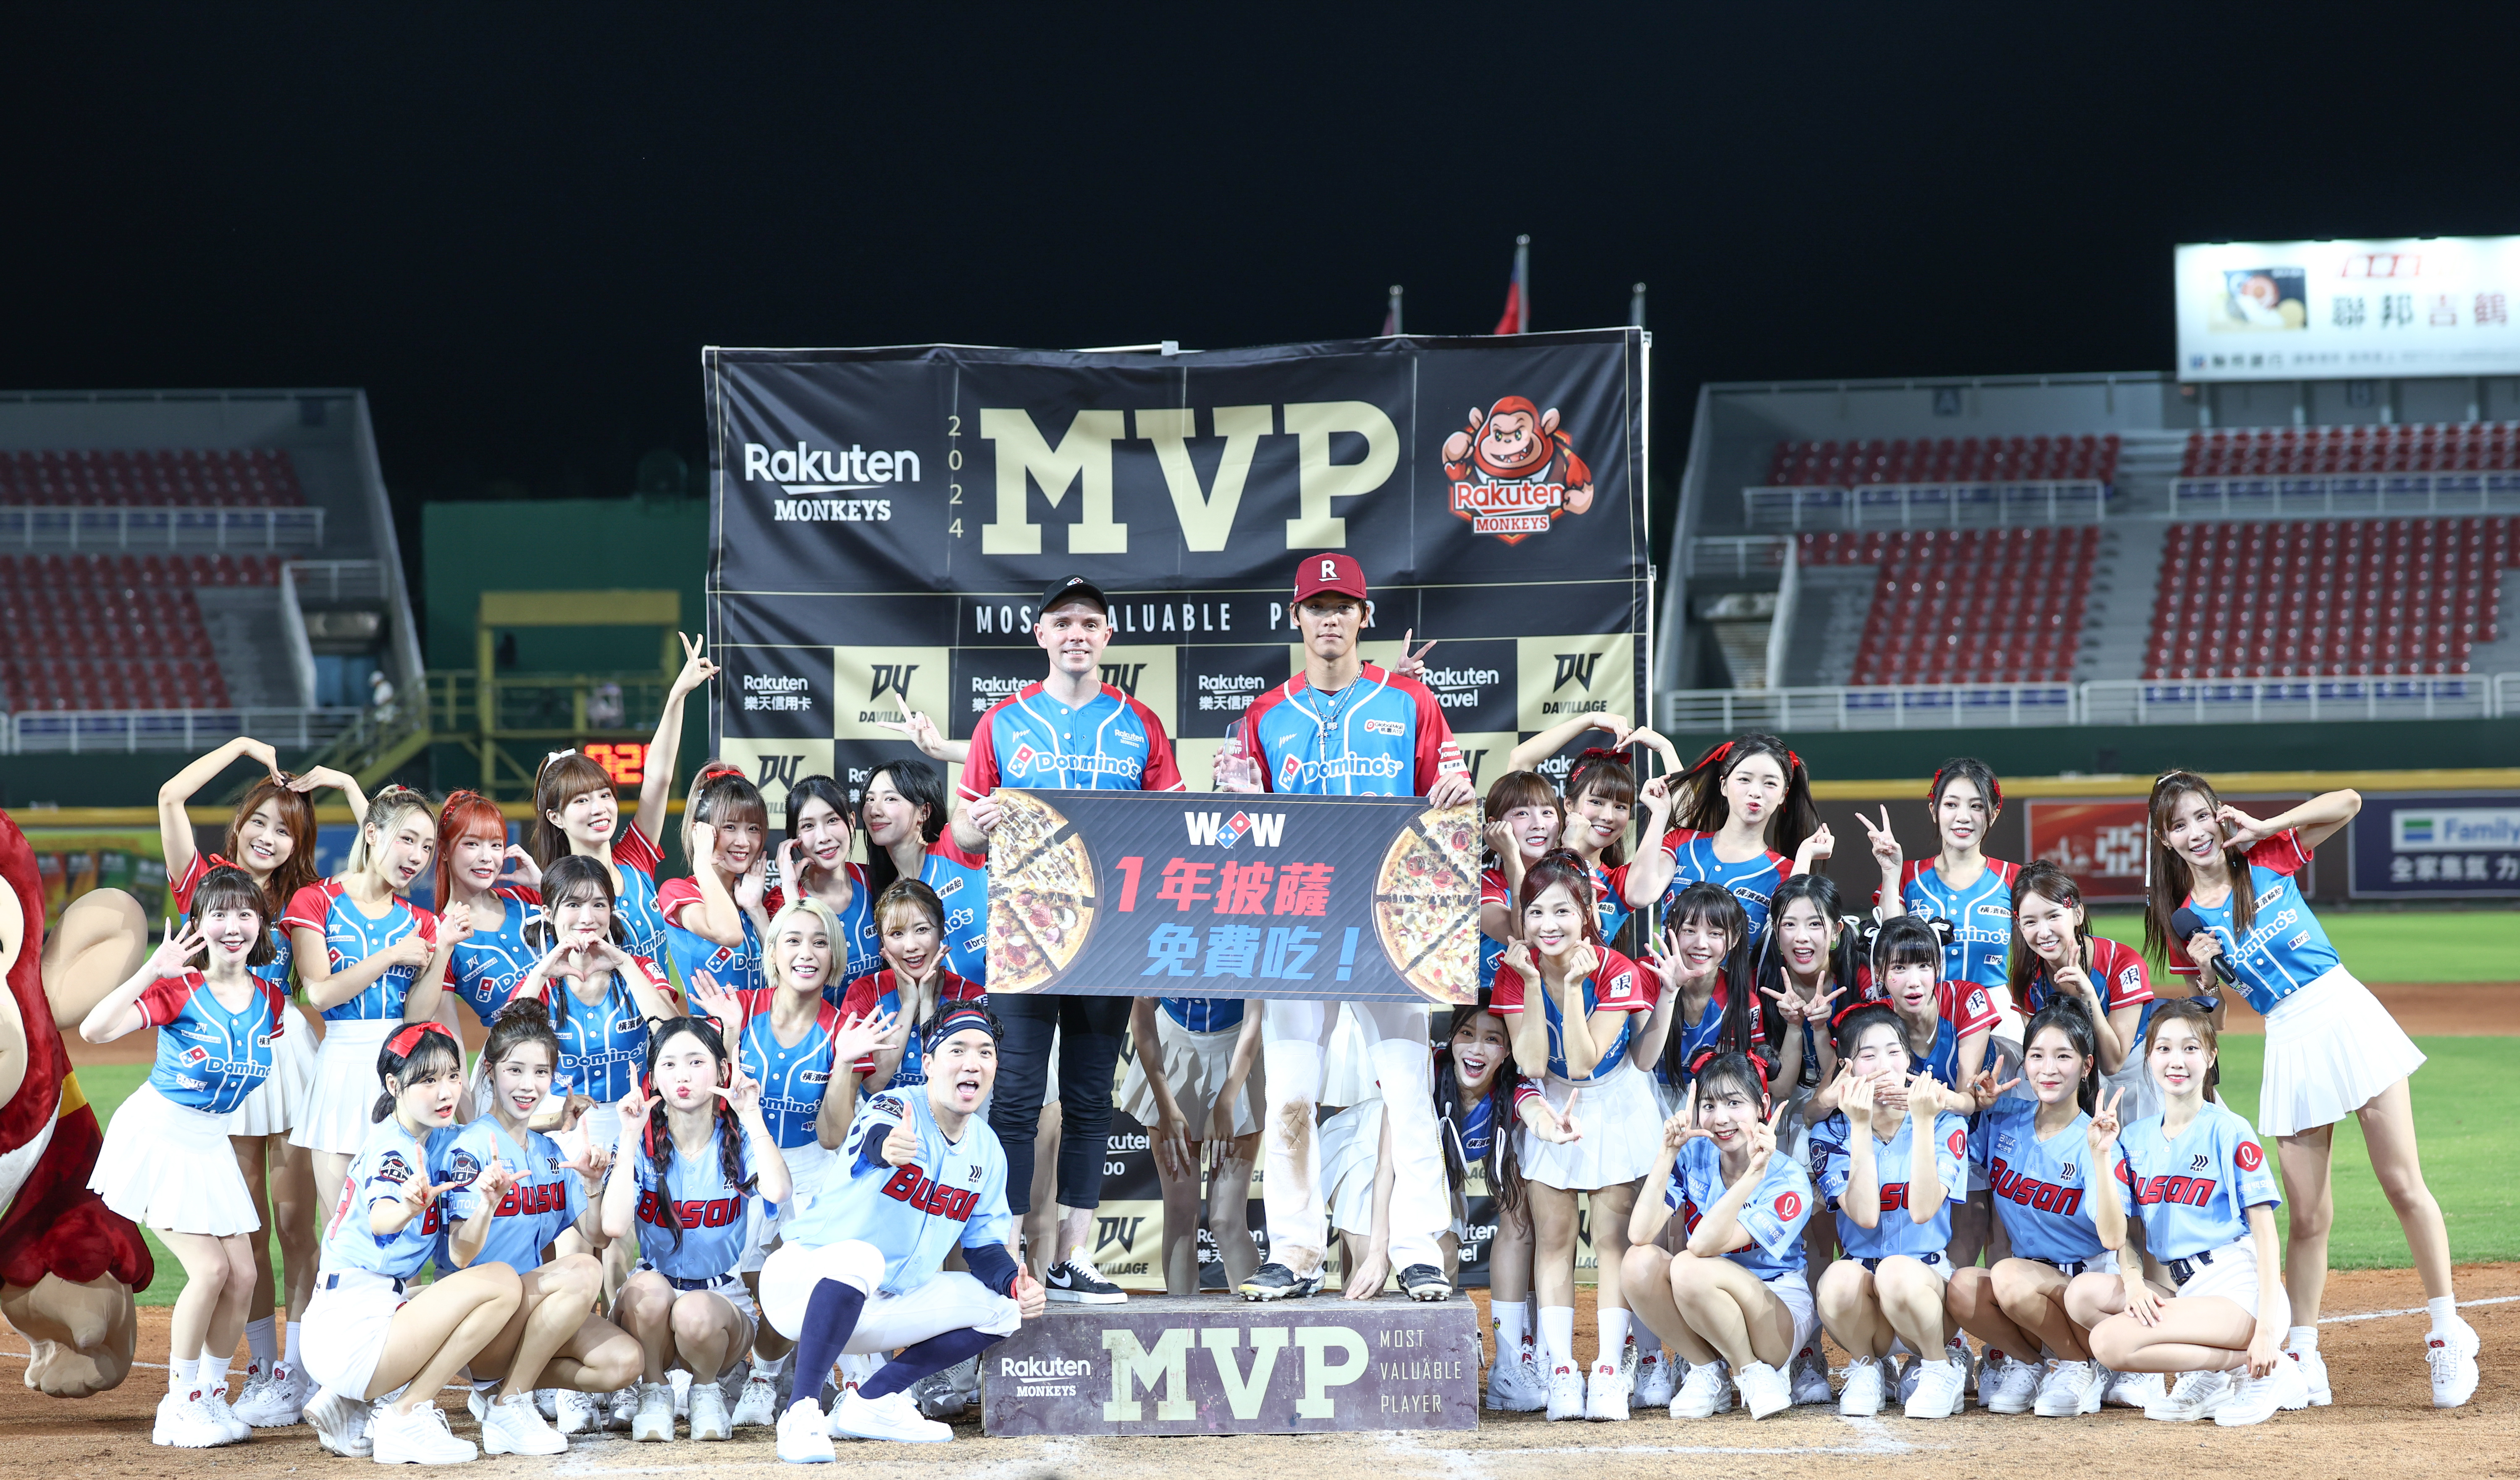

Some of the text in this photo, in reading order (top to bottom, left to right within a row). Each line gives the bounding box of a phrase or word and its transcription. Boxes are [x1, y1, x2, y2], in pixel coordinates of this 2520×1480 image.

[746, 442, 920, 482] Rakuten
[948, 415, 964, 538] 2024
[980, 400, 1399, 555] MVP
[1456, 480, 1563, 507] Rakuten
[774, 499, 891, 521] MONKEYS
[1476, 517, 1549, 531] MONKEYS
[1321, 560, 1337, 578] R
[976, 603, 1231, 634] MOS ALUABLE
[744, 675, 808, 691] Rakuten
[972, 676, 1037, 692] Rakute
[1199, 674, 1265, 690] Rakuten
[1423, 667, 1499, 686] Rakuten
[744, 696, 812, 711] 樂天信用卡
[1199, 695, 1255, 710] 樂天信用
[1433, 689, 1478, 707] ravel
[1543, 700, 1607, 714] DAVILLAGE
[1115, 728, 1144, 743] Rakuten
[1229, 746, 1242, 754] MVP
[1302, 752, 1398, 784] Domino's
[937, 878, 962, 899] 濱輪胎
[1115, 855, 1335, 917] 1年披薩
[971, 936, 987, 947] brg
[1953, 925, 2011, 945] mino's
[2296, 932, 2310, 944] brg
[1108, 1133, 1150, 1150] kuten
[1095, 1262, 1149, 1275] AVILLAGE
[1380, 1329, 1425, 1347] MOST
[1001, 1357, 1091, 1376] Rakuten
[1102, 1326, 1369, 1421] MVP
[1381, 1361, 1462, 1380] VALUABLE
[281, 1393, 291, 1401] FILA
[1016, 1385, 1076, 1397] MONKEYS
[1381, 1394, 1442, 1413] PLAYER
